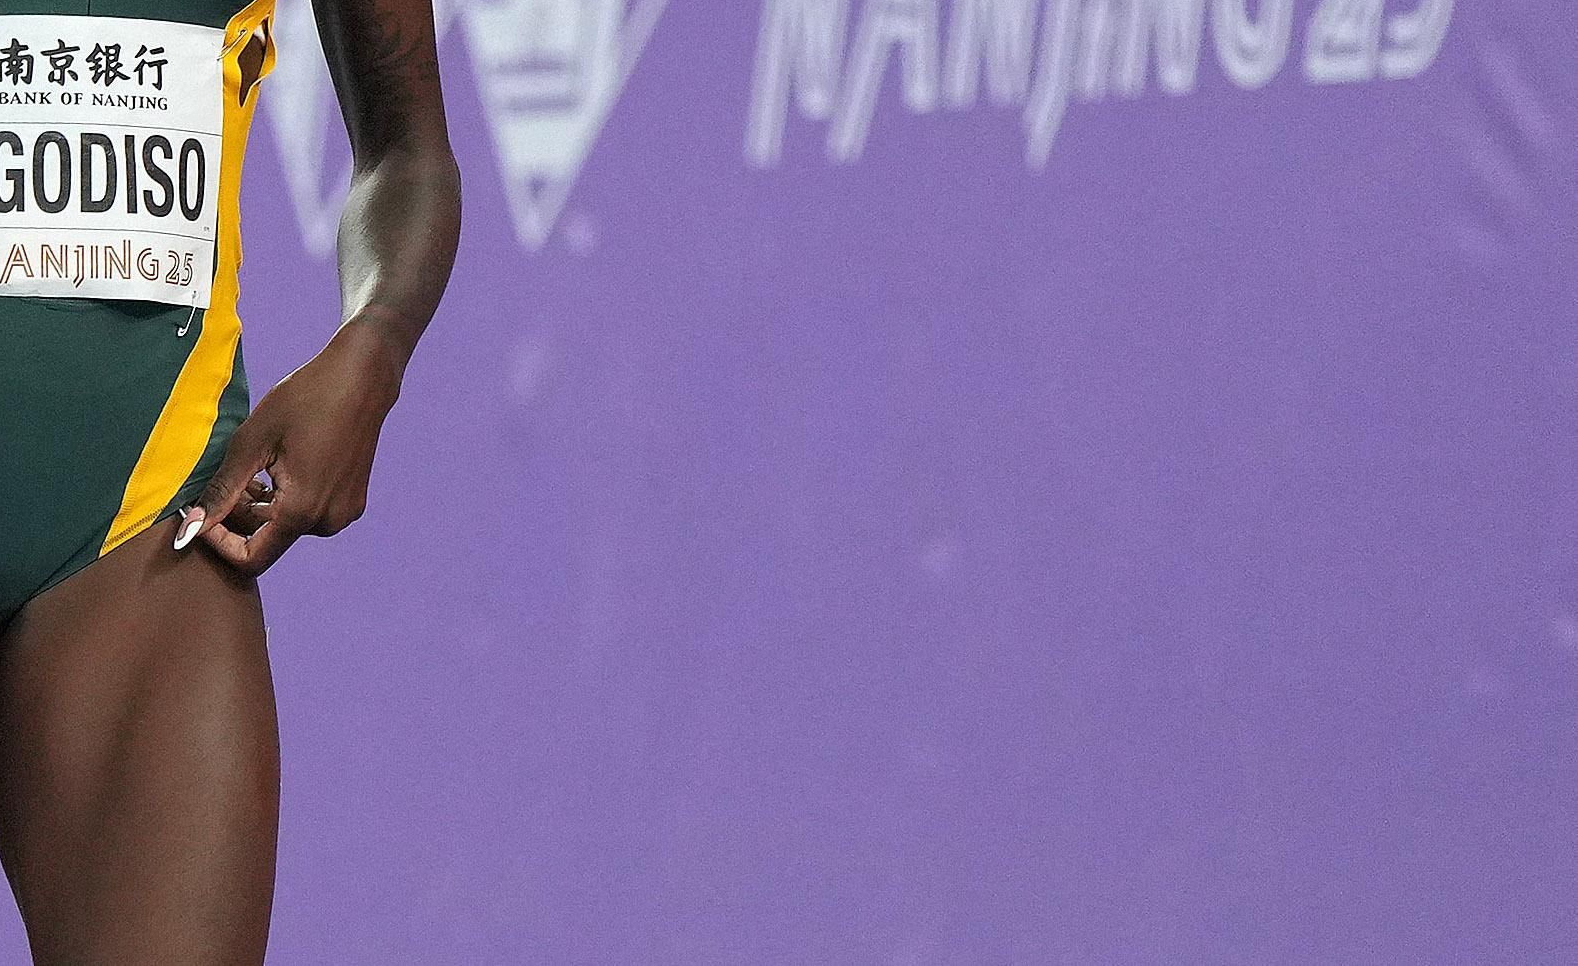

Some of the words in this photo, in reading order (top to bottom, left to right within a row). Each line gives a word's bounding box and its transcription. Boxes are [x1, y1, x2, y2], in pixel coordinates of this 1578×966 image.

[60, 92, 83, 106] OF
[92, 94, 168, 111] NANJING
[165, 249, 194, 287] 25
